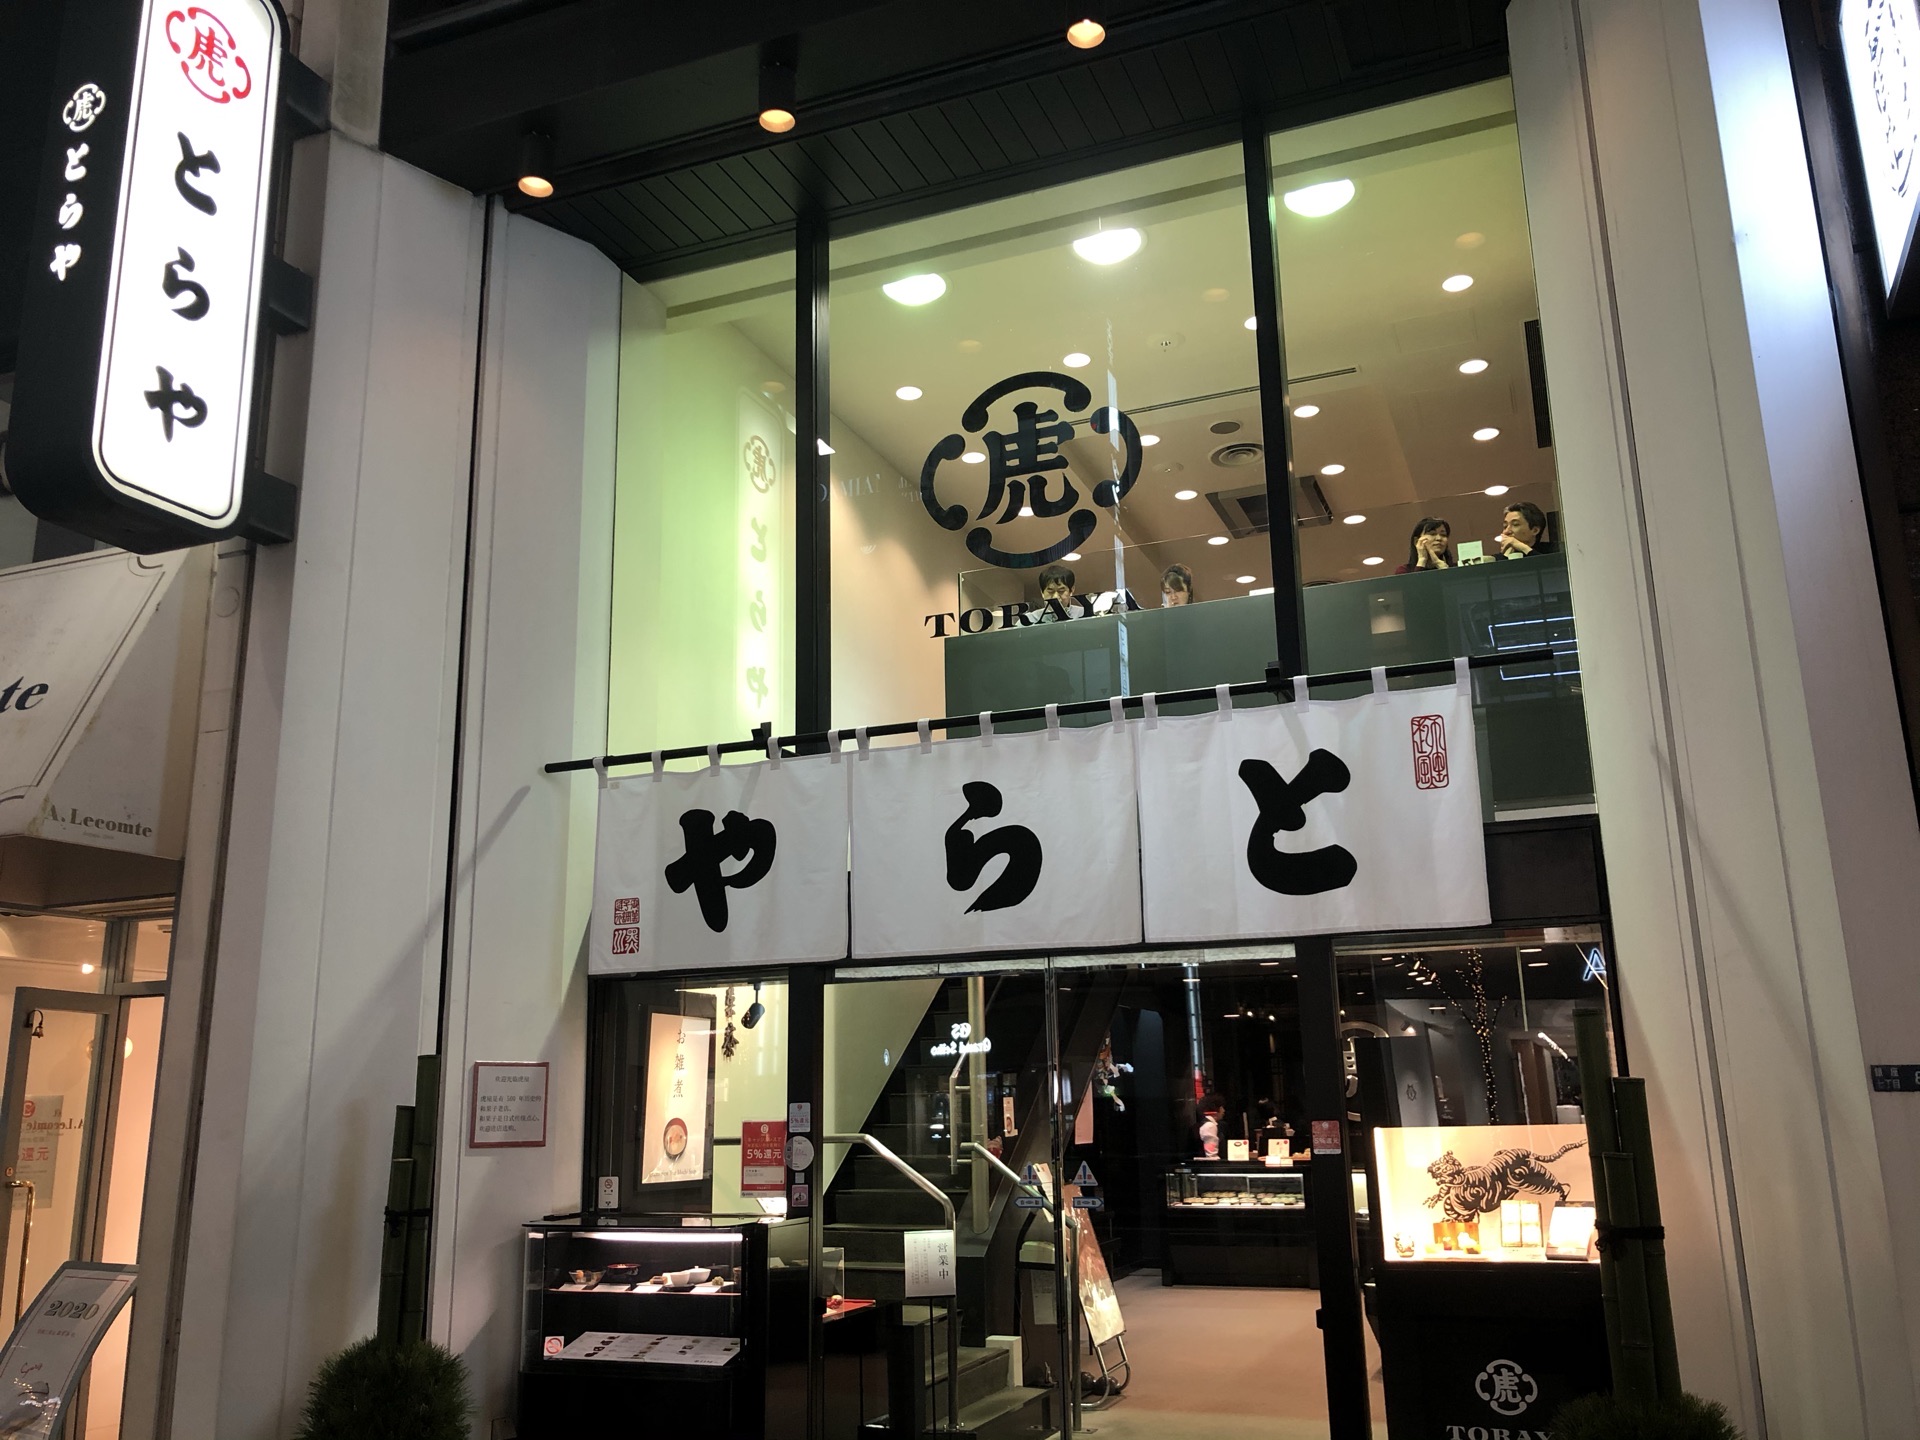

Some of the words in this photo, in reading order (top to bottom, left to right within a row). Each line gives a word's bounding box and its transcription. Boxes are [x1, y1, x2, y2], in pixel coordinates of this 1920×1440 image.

[49, 142, 90, 282] とらや
[144, 131, 221, 443] とらや
[924, 588, 1141, 639] TORAYA
[672, 1028, 686, 1098] お雑煮
[746, 1148, 782, 1159] 5%還元
[937, 1242, 949, 1280] 営業中
[43, 1299, 100, 1321] 2020
[1446, 1425, 1554, 1440] TORAY
